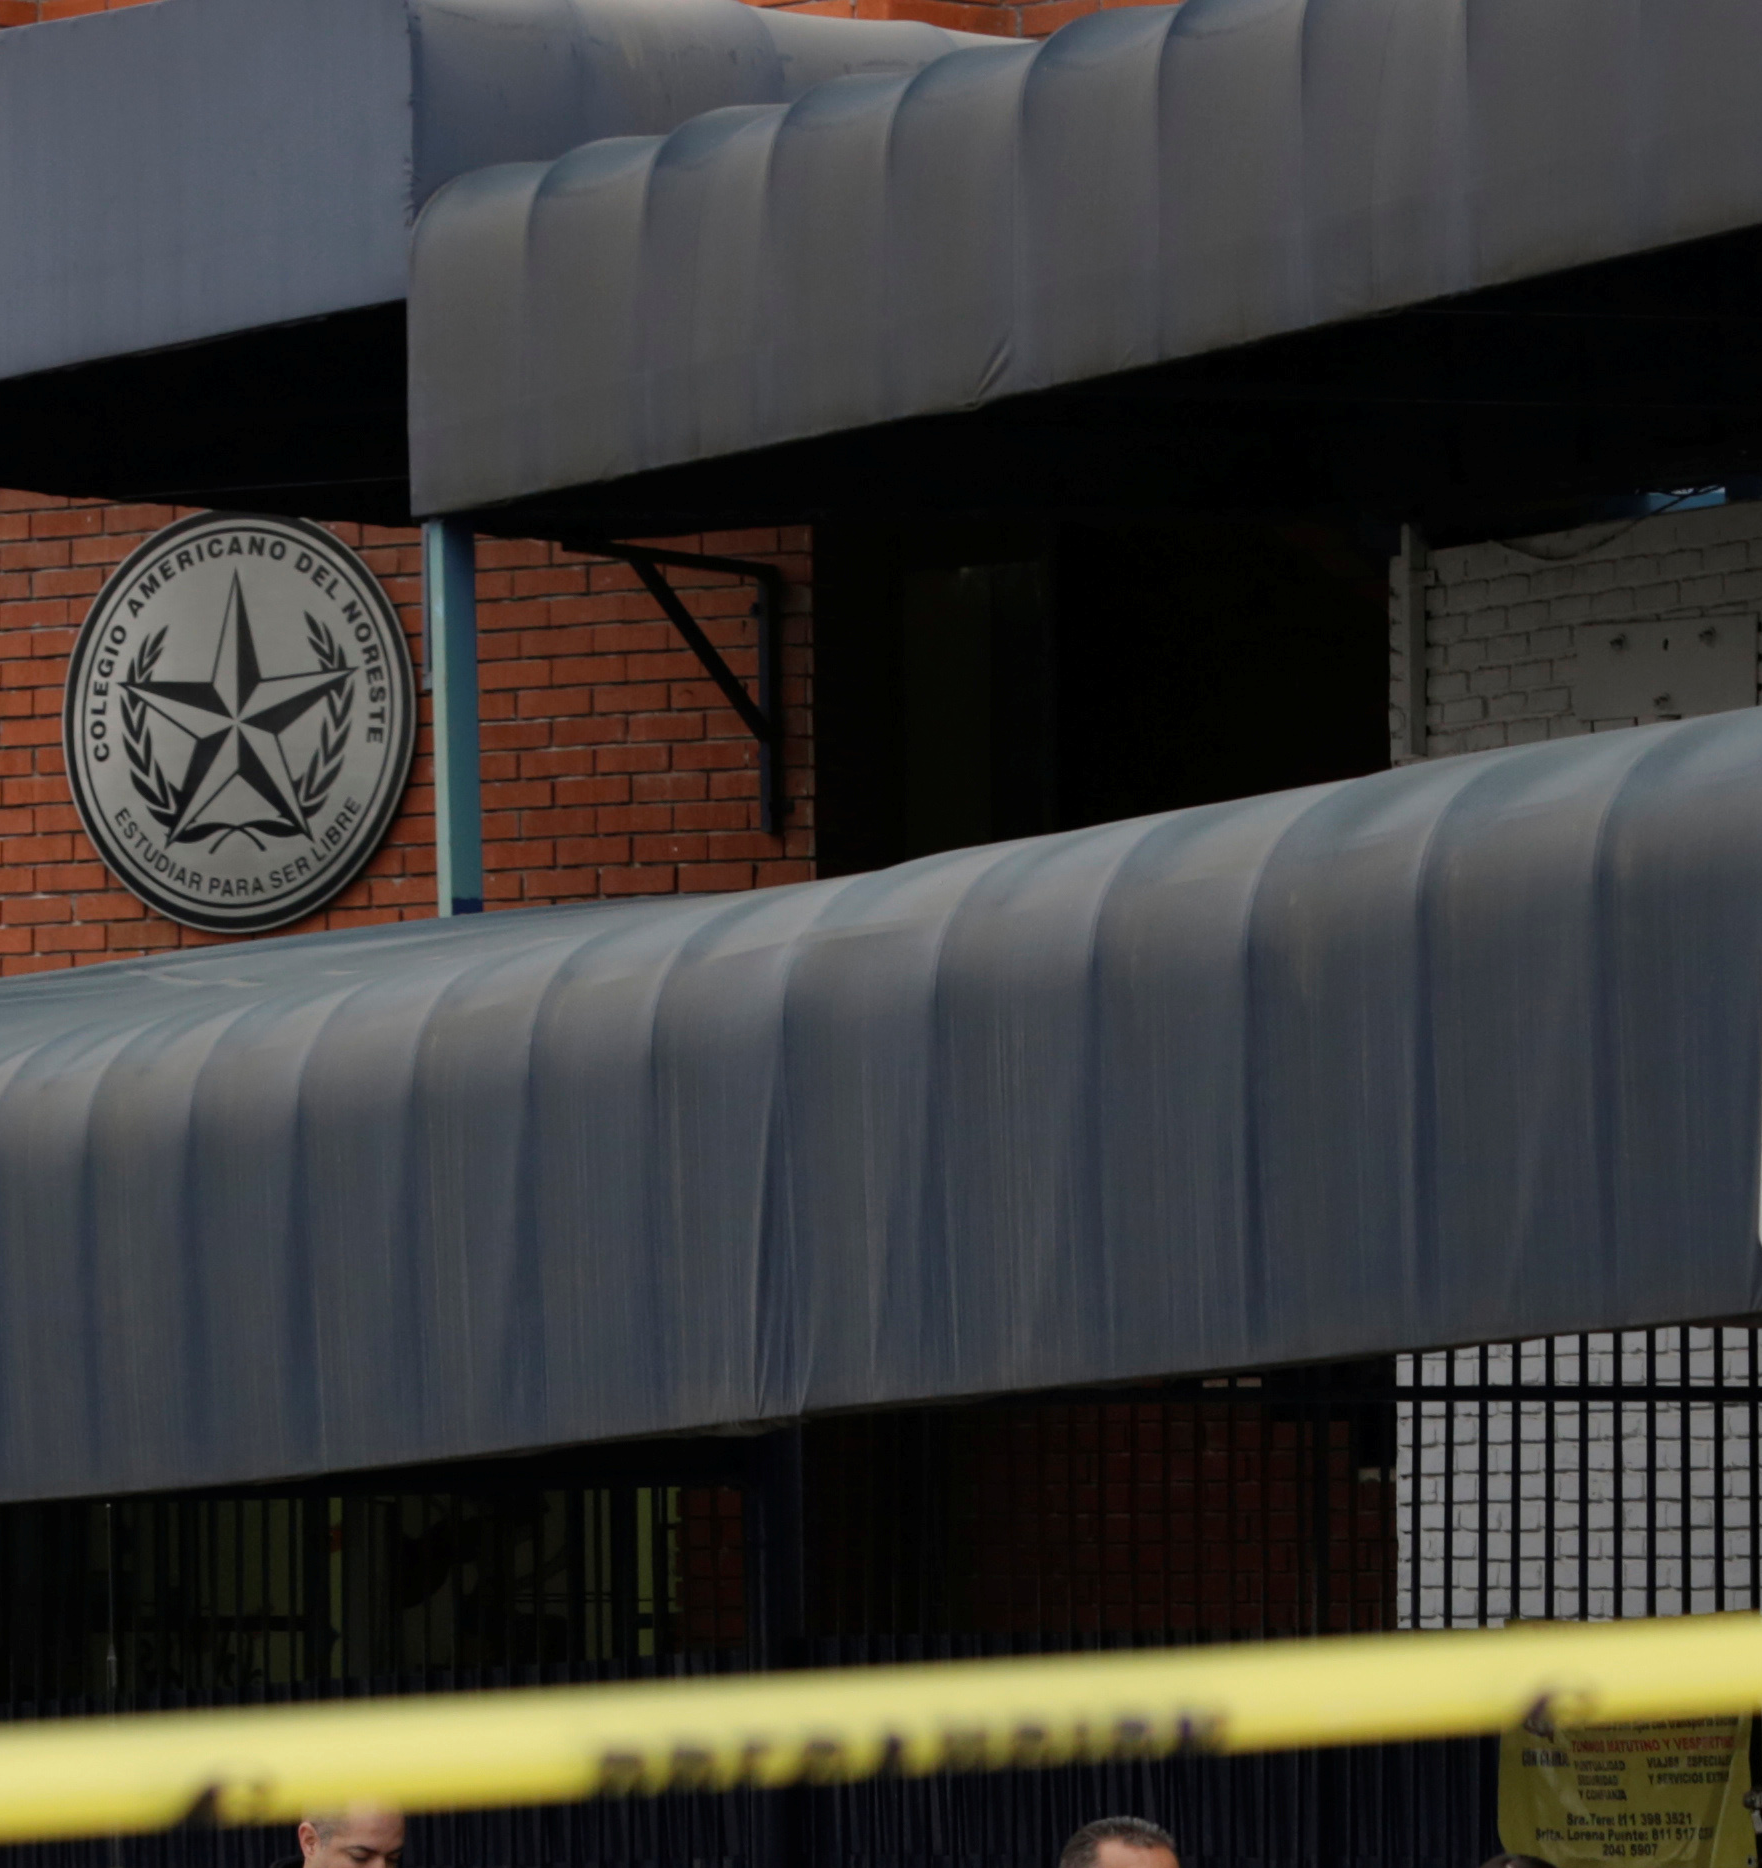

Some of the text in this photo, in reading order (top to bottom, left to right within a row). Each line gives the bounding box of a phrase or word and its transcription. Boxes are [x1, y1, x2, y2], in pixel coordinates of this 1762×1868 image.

[90, 536, 387, 764] COLEGIO AMERICANO DEL NORESTE
[114, 795, 363, 898] ESTUDIAR PARA SER LIBRE
[1567, 1828, 1605, 1842] Lorena
